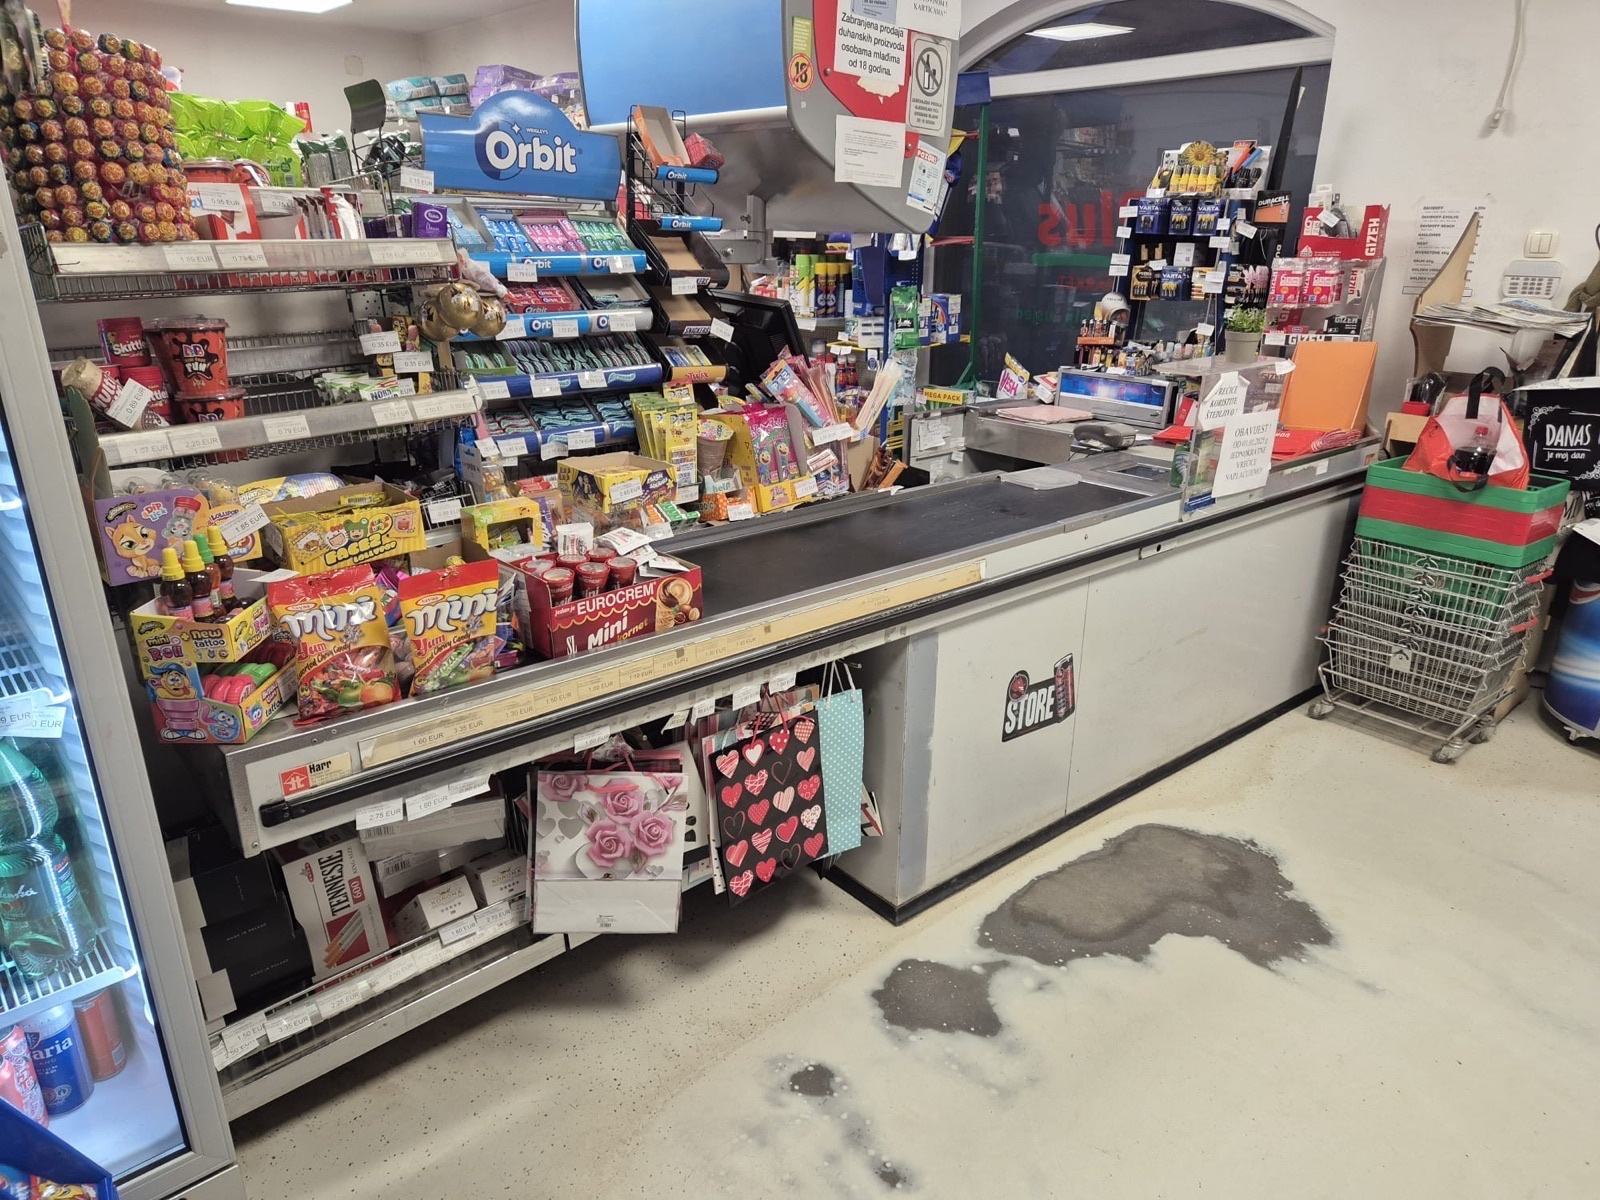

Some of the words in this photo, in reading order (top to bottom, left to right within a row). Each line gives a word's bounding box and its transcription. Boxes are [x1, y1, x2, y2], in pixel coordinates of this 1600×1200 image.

[841, 12, 878, 32] Zabranjena
[879, 22, 904, 38] prodaja
[838, 27, 872, 45] duhanskih
[873, 36, 905, 52] proizvoda
[841, 43, 872, 58] osobama
[848, 58, 857, 69] od
[859, 60, 867, 71] 18
[485, 130, 577, 173] Orbit
[667, 171, 687, 180] Orbit
[1258, 195, 1290, 207] DURACELL
[672, 220, 692, 228] Orbit
[1365, 218, 1380, 257] GIZEH
[532, 319, 552, 330] Orb
[943, 392, 960, 401] PACK
[202, 437, 218, 447] EUR
[1545, 424, 1592, 447] DANAS
[1545, 451, 1554, 462] je
[1555, 452, 1569, 462] moj
[1571, 451, 1586, 459] dan
[235, 520, 250, 533] 1.85
[250, 512, 264, 526] EUR
[577, 583, 655, 616] EUROCREM
[280, 595, 377, 641] mini
[405, 588, 498, 636] mini
[190, 629, 223, 640] new
[587, 610, 629, 651] Mini
[146, 634, 170, 647] mini
[194, 639, 225, 648] tattoo
[1005, 685, 1055, 734] STORE
[10, 711, 31, 722] EUR
[40, 720, 62, 728] EUR
[468, 720, 484, 730] EUR
[428, 732, 444, 742] EUR
[309, 760, 332, 774] Harr
[433, 796, 448, 806] EUR
[385, 808, 402, 817] EUR
[318, 850, 350, 917] TENNESIE
[351, 881, 362, 899] 600
[463, 922, 476, 931] EUR
[294, 1016, 308, 1026] EUR
[31, 1037, 73, 1060] aria
